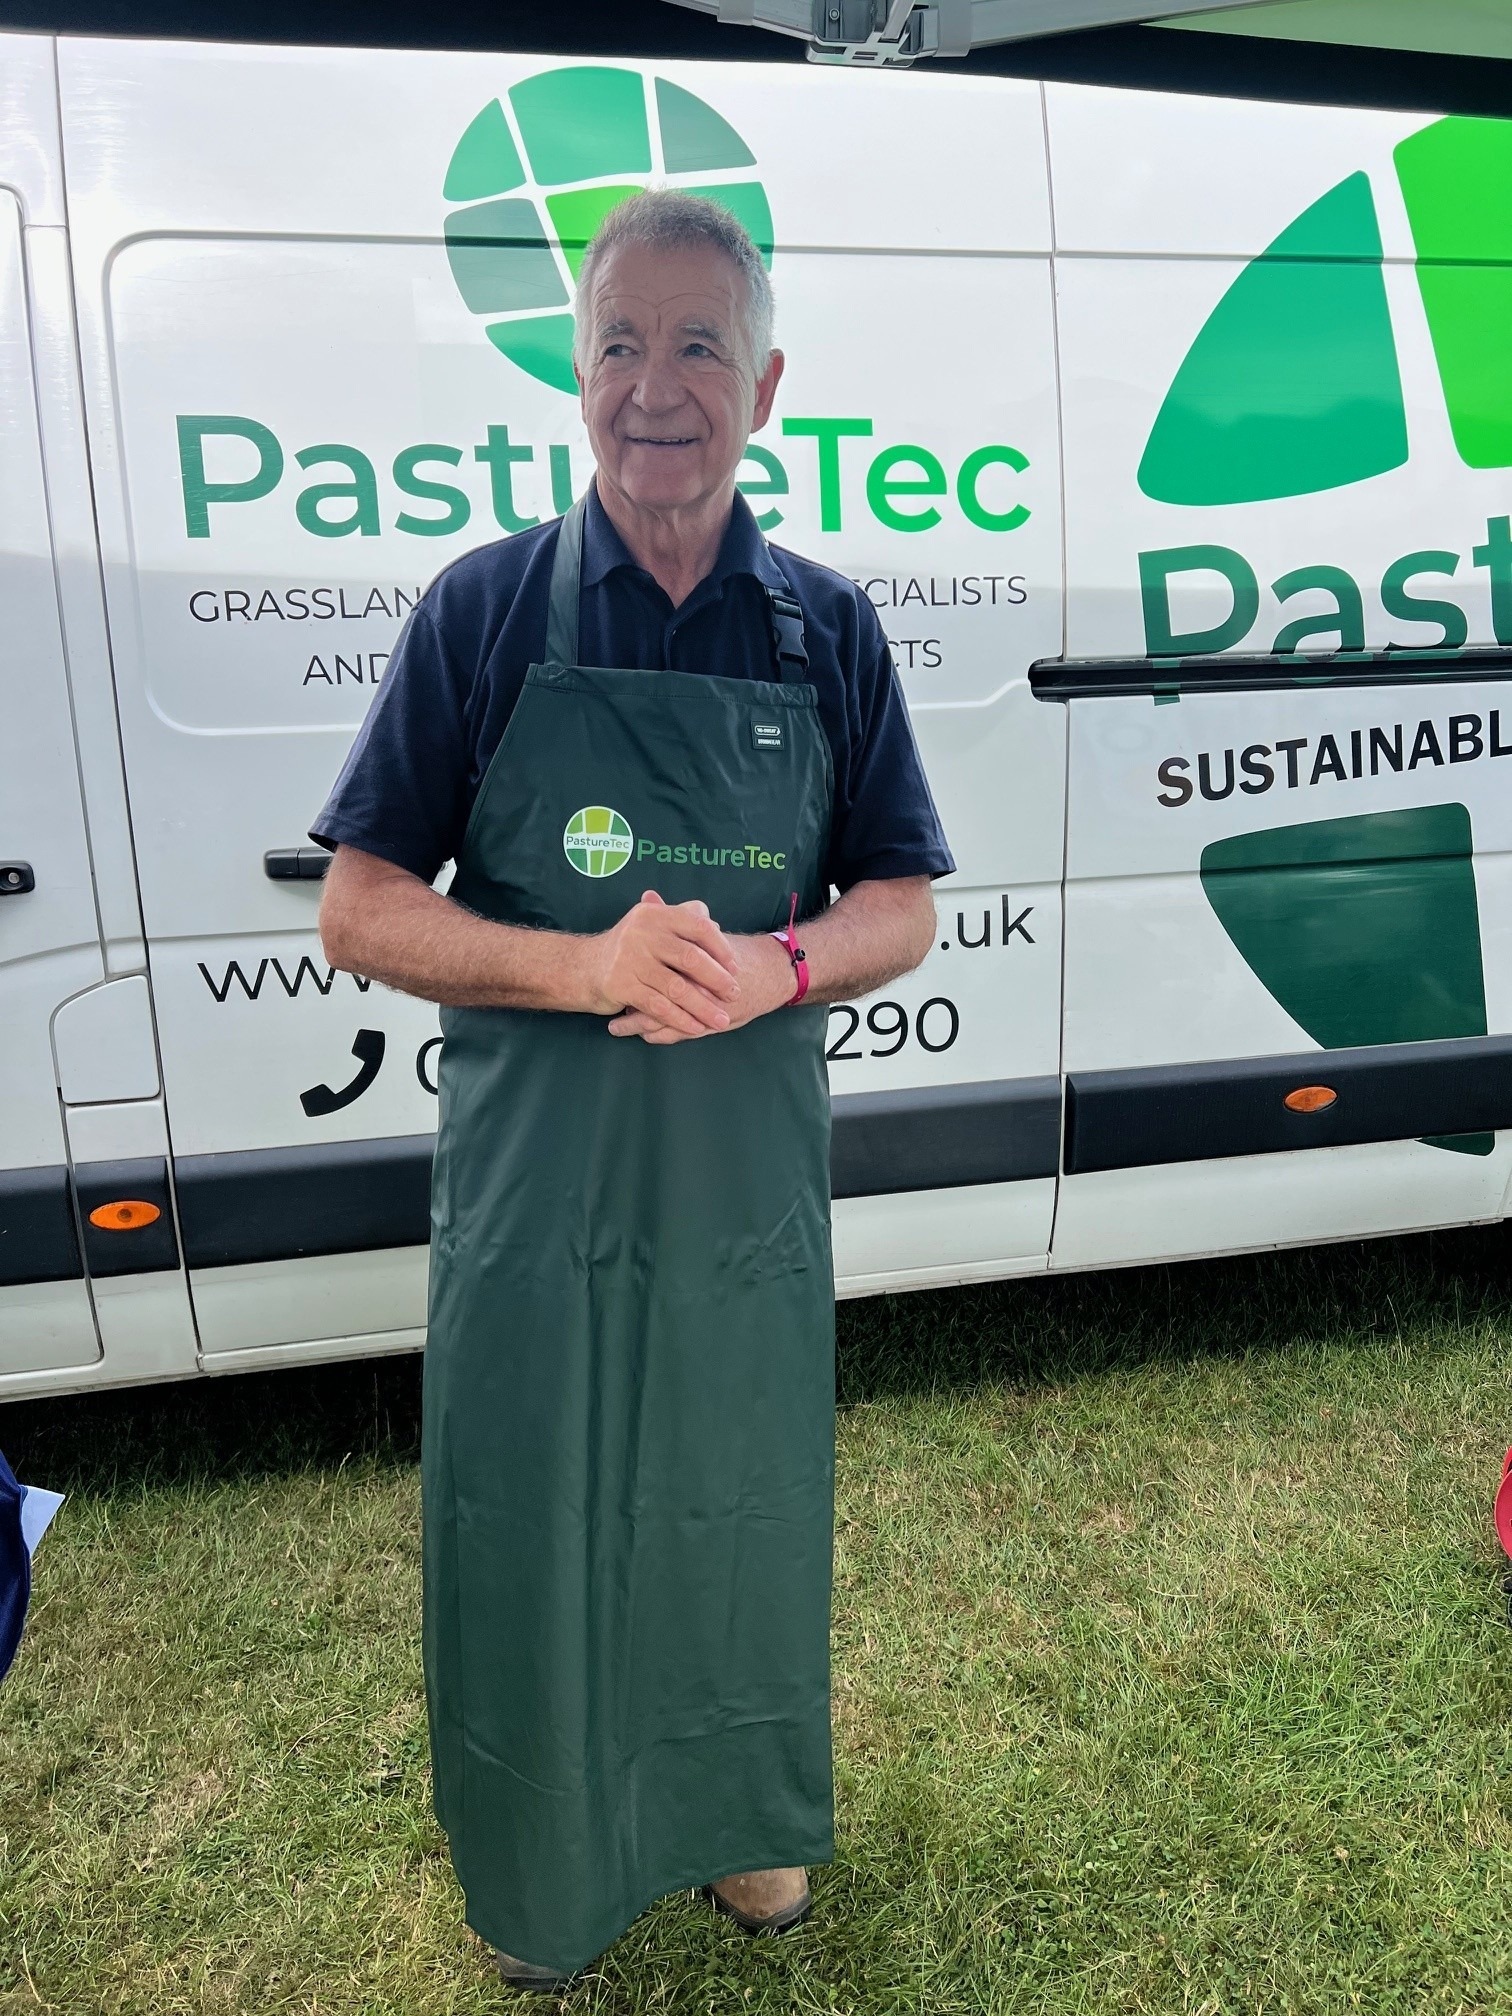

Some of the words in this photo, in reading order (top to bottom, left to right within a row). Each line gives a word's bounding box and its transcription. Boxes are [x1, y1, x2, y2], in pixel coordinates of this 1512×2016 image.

[175, 414, 1032, 539] PasteTec
[189, 586, 421, 623] GRASSLAN
[851, 576, 1028, 608] CIALISTS
[1156, 709, 1512, 808] SUSTAINABL
[566, 836, 630, 850] PastureTec
[636, 838, 786, 870] PastureTec
[197, 956, 371, 1003] ww
